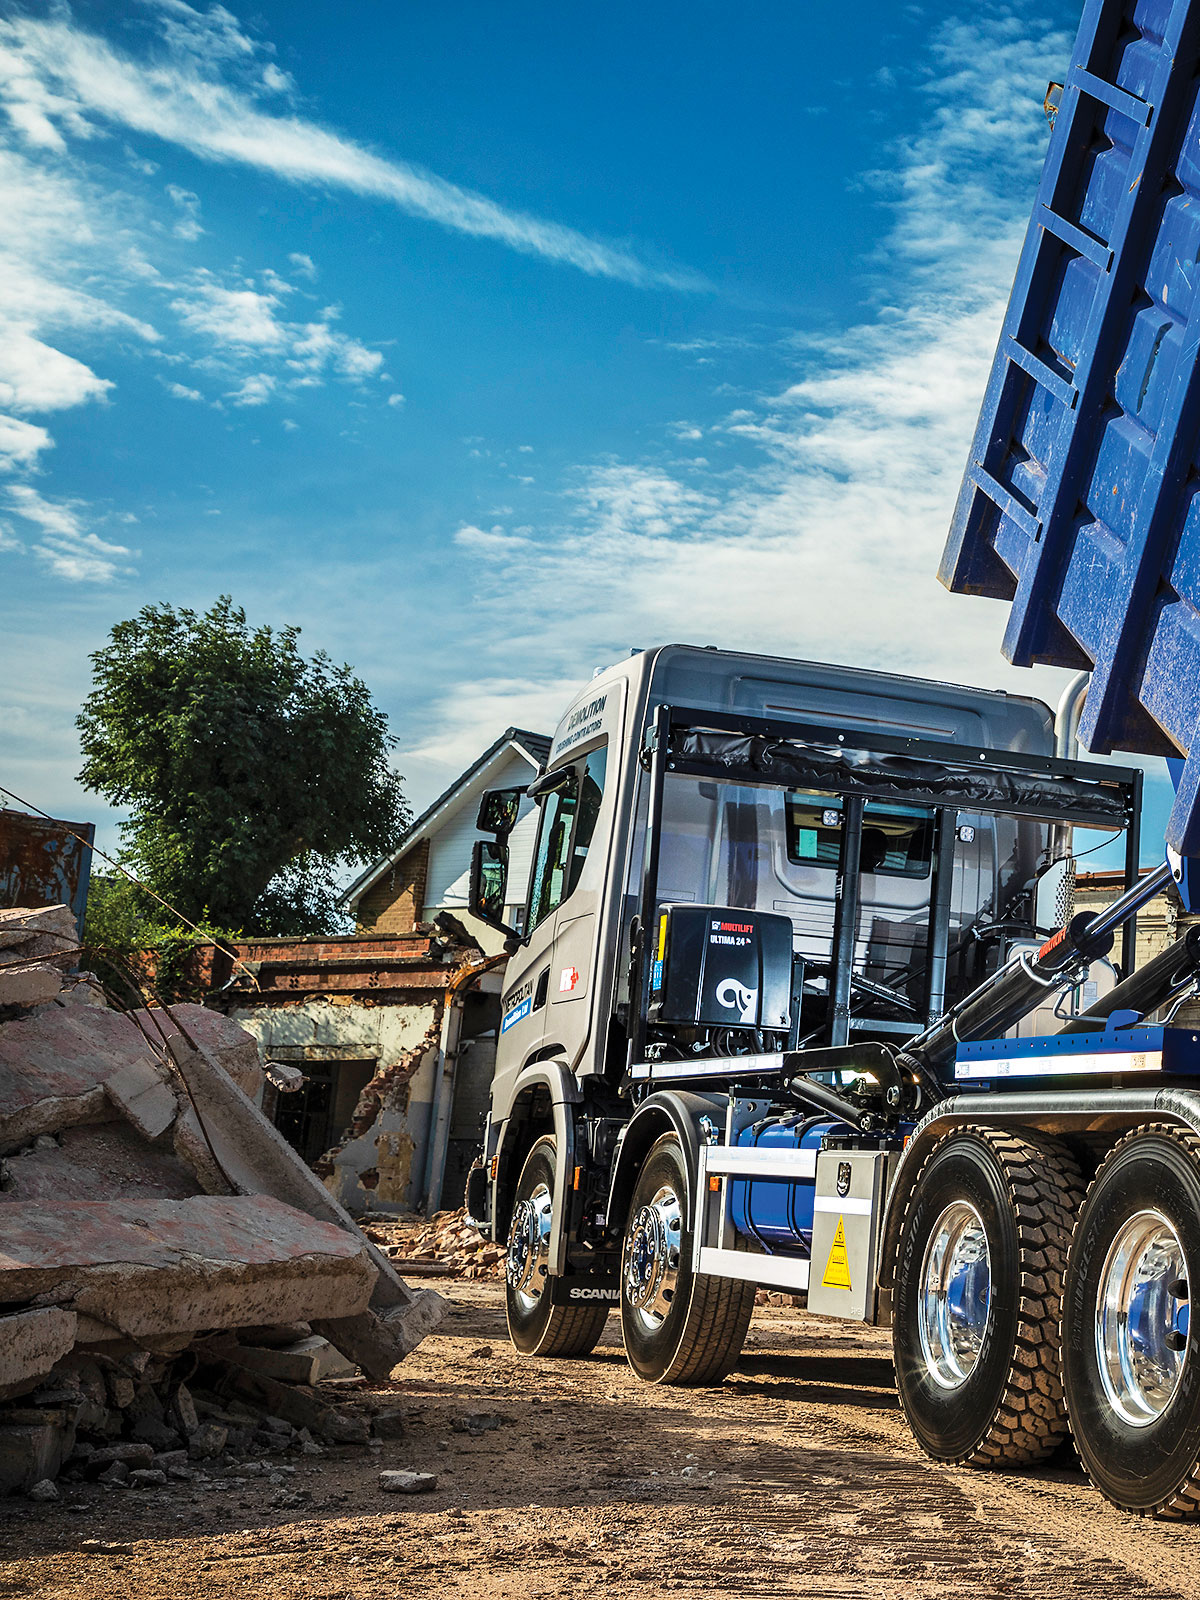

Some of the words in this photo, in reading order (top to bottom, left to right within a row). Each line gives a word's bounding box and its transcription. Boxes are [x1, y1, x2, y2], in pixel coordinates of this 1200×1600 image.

[720, 922, 754, 934] MULTILIFT
[710, 934, 735, 945] ULTIMA
[736, 937, 745, 946] 24
